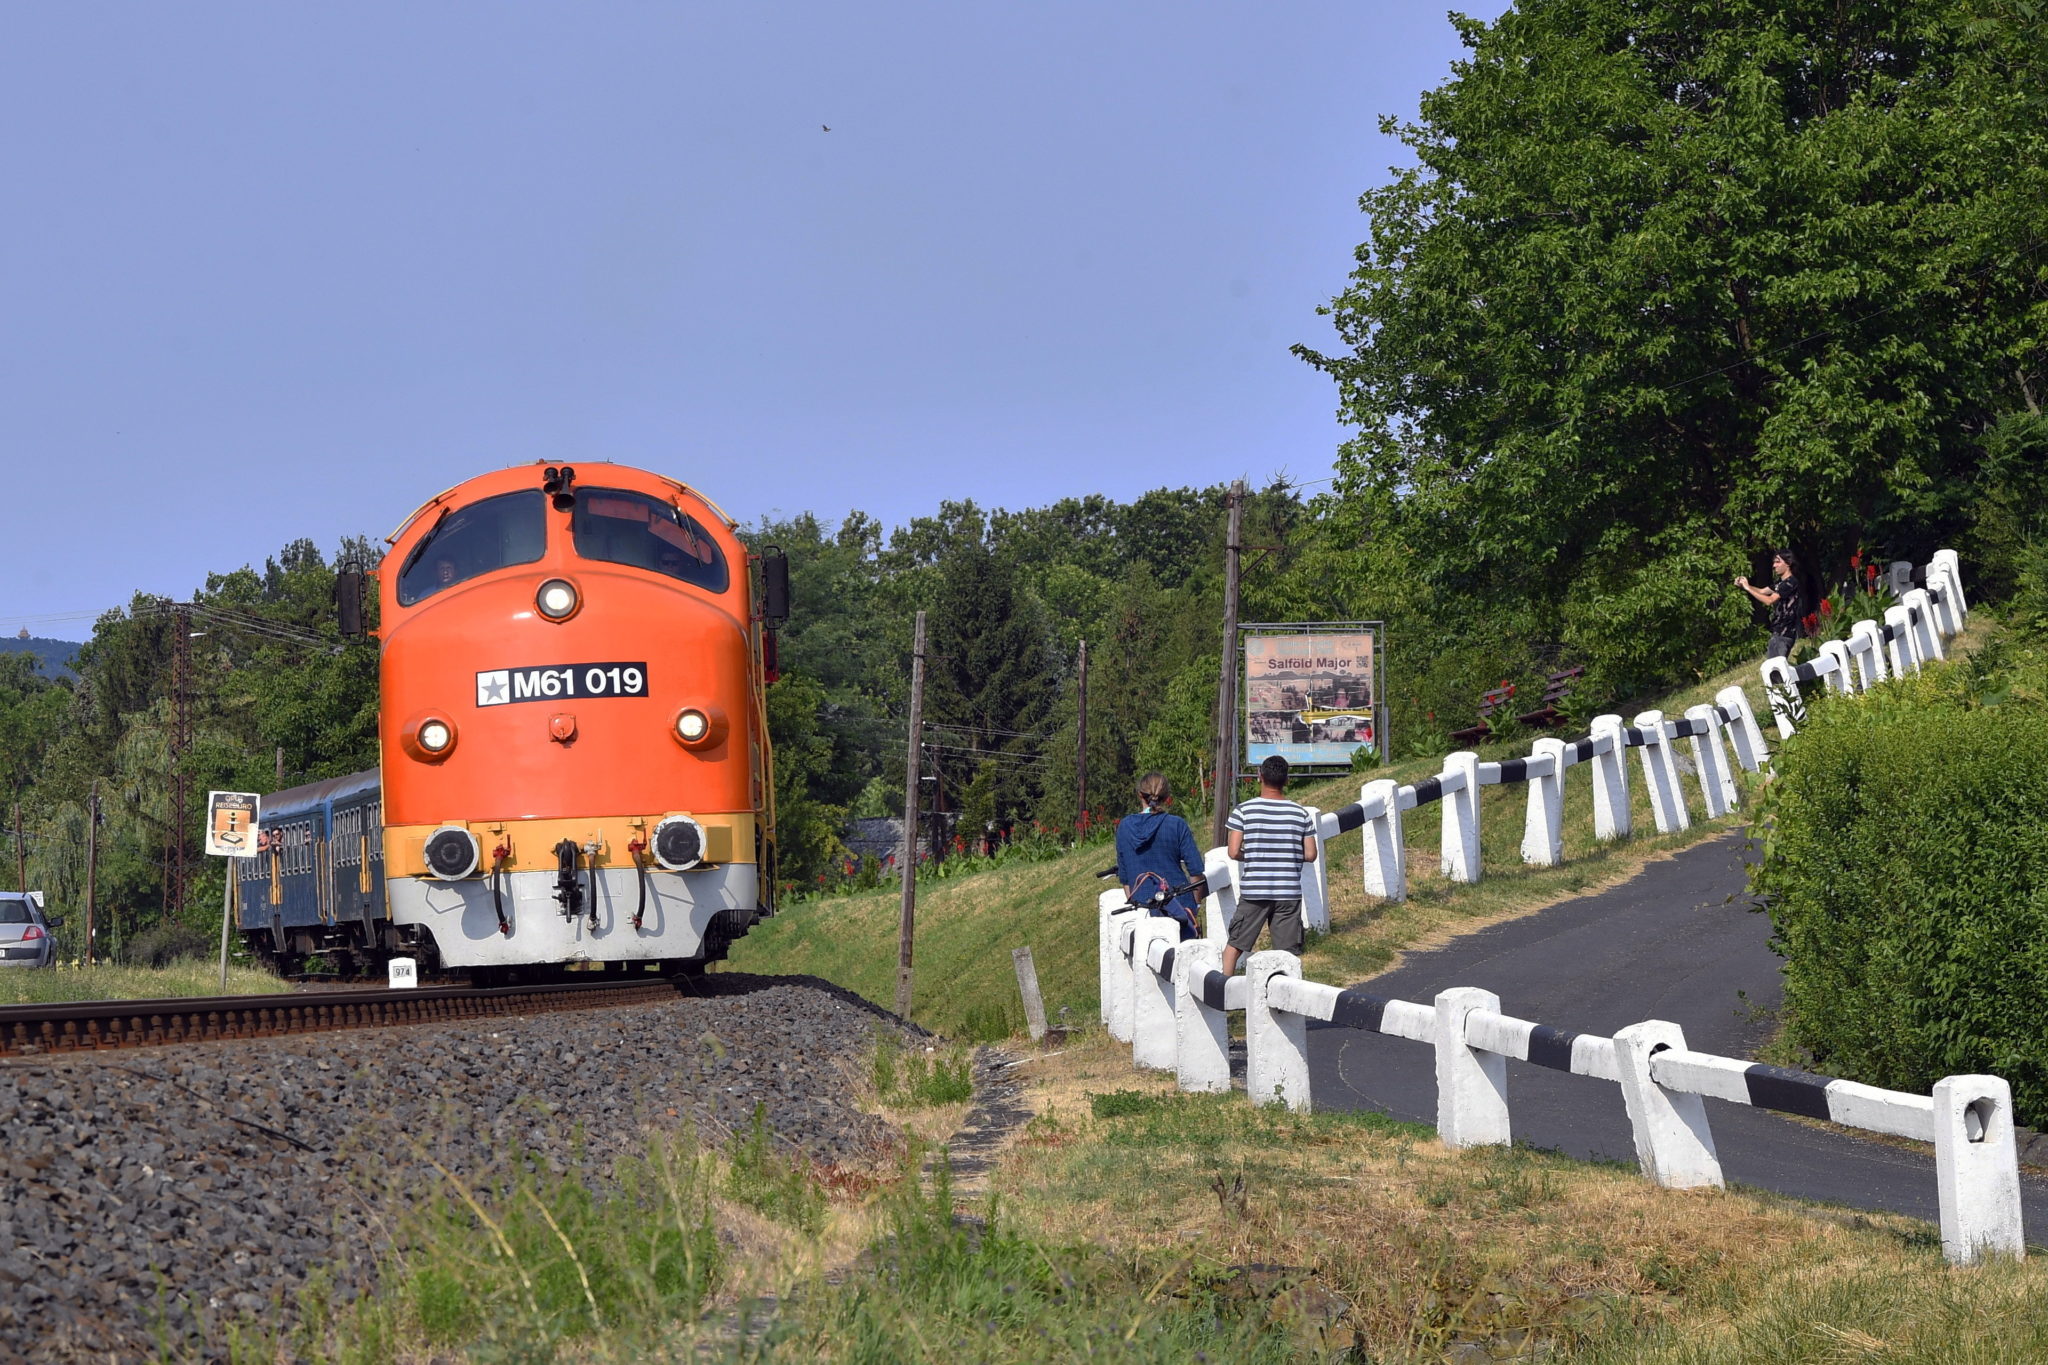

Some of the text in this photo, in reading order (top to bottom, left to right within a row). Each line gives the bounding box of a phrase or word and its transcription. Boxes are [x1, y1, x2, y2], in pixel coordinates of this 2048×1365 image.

[1268, 657, 1352, 671] Salföld Major
[513, 667, 643, 698] M61 019
